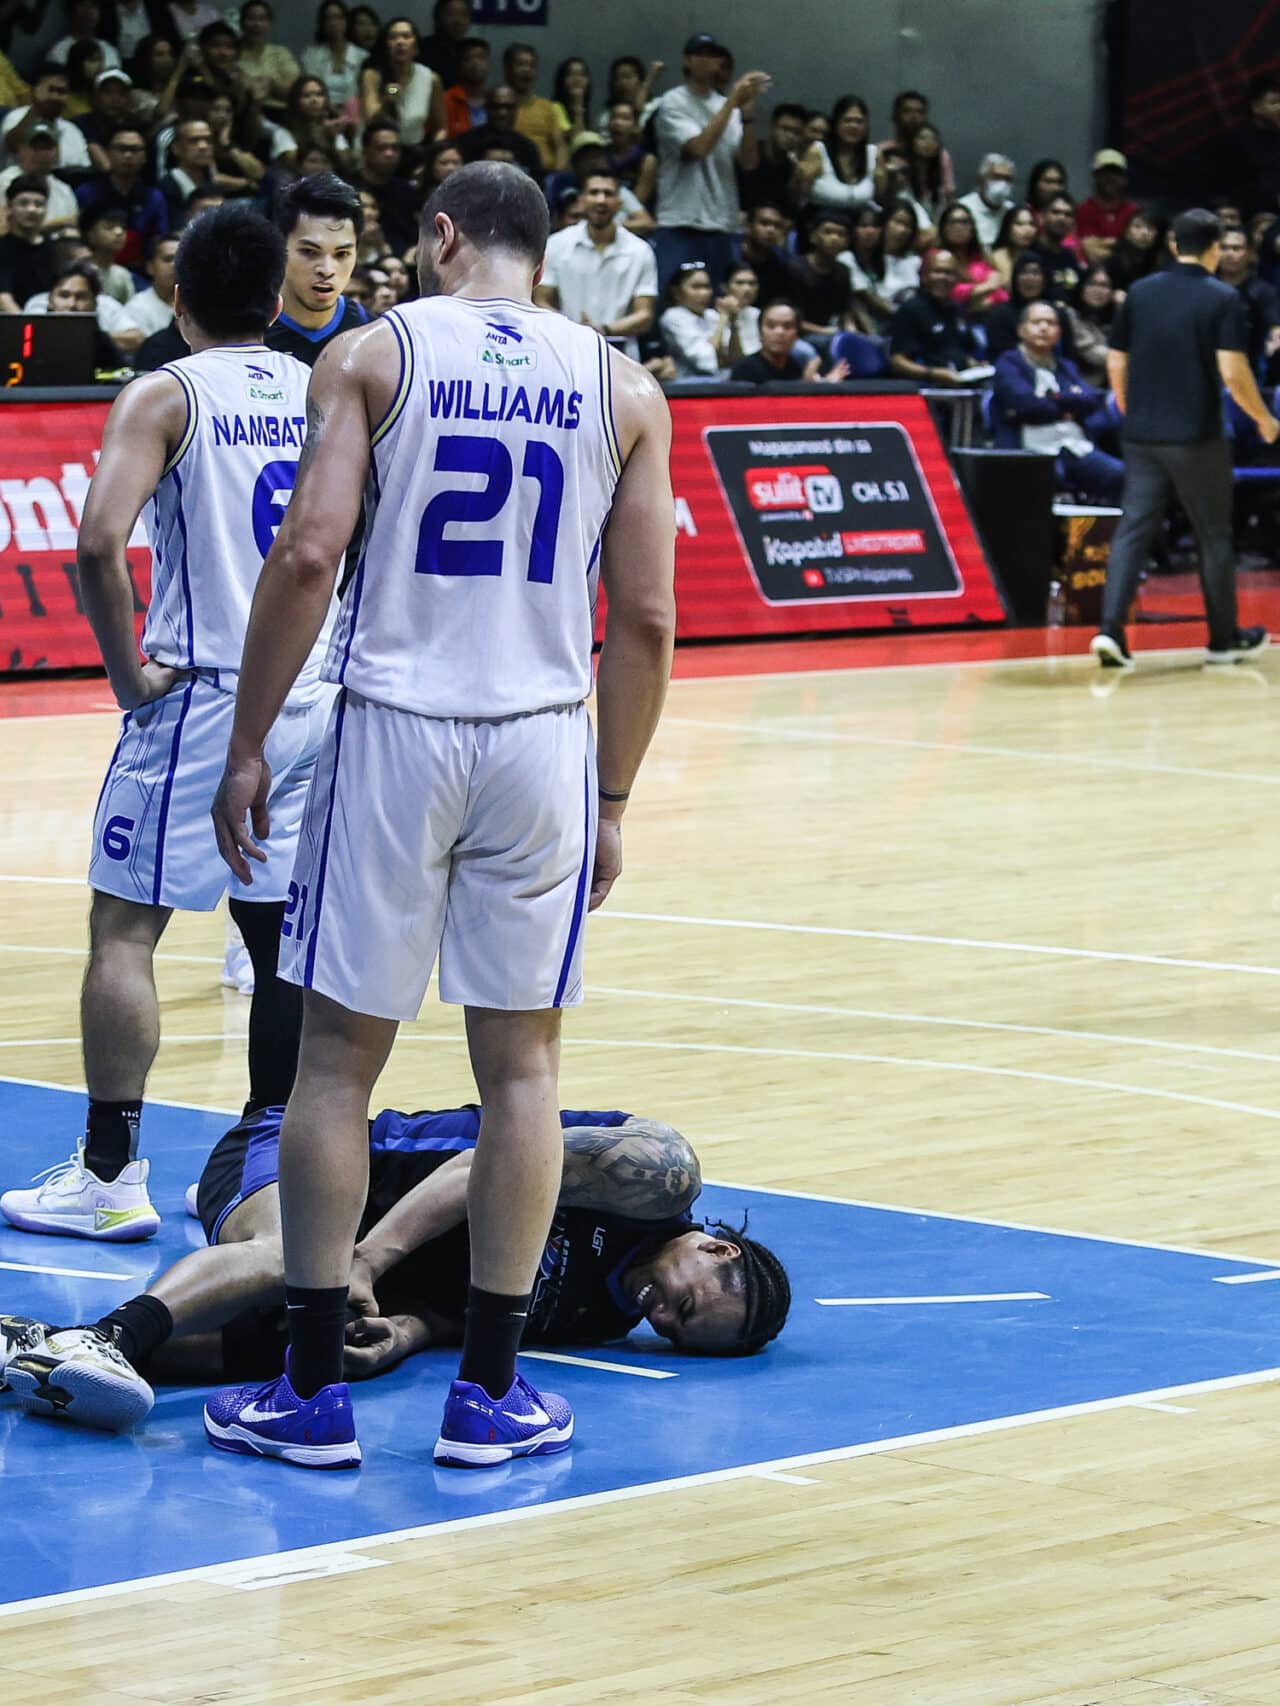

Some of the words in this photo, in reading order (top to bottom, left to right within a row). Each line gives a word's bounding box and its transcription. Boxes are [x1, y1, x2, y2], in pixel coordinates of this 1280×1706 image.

[486, 332, 508, 345] ANTA
[495, 352, 531, 367] Smart
[429, 379, 583, 430] WILLIAMS
[212, 413, 305, 448] NAMBAT
[415, 434, 564, 584] 21
[763, 531, 844, 566] Kapatid
[103, 815, 135, 861] 6
[281, 880, 308, 941] 21
